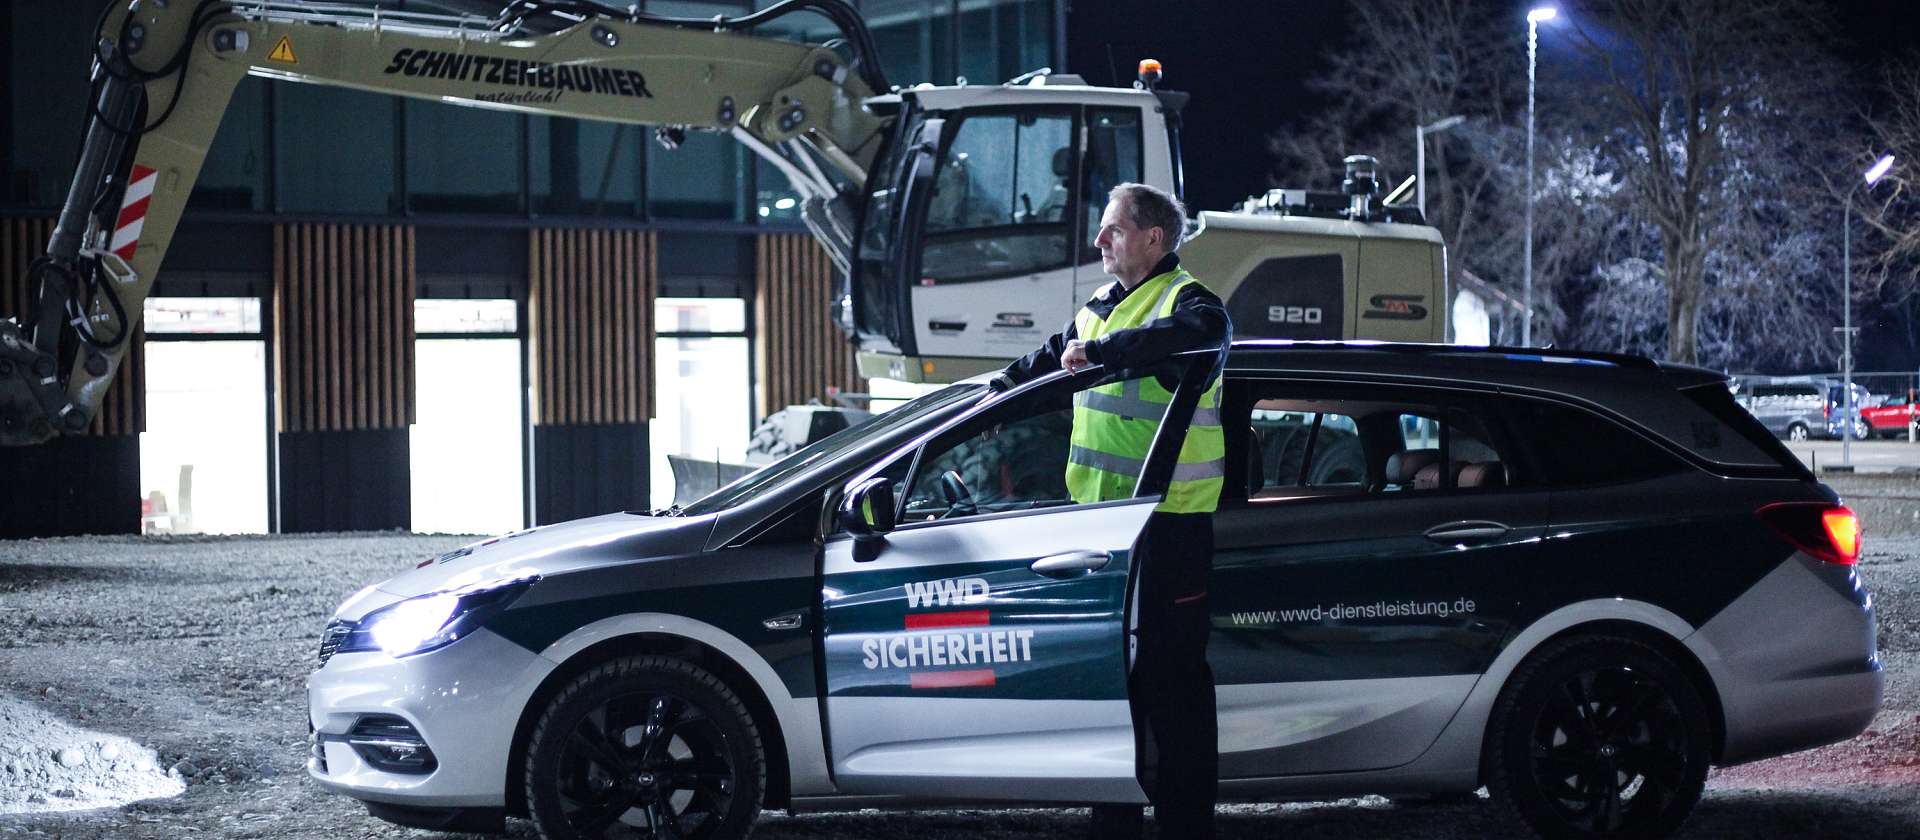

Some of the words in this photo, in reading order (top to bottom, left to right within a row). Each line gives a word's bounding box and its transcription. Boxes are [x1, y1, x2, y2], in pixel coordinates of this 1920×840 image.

[384, 49, 653, 98] SCHNITZENBAUMER
[1268, 306, 1322, 324] 920
[904, 578, 989, 608] WWD
[1231, 597, 1476, 625] www.wwd-dienstleistung.de
[862, 629, 1034, 670] SICHERHEIT
